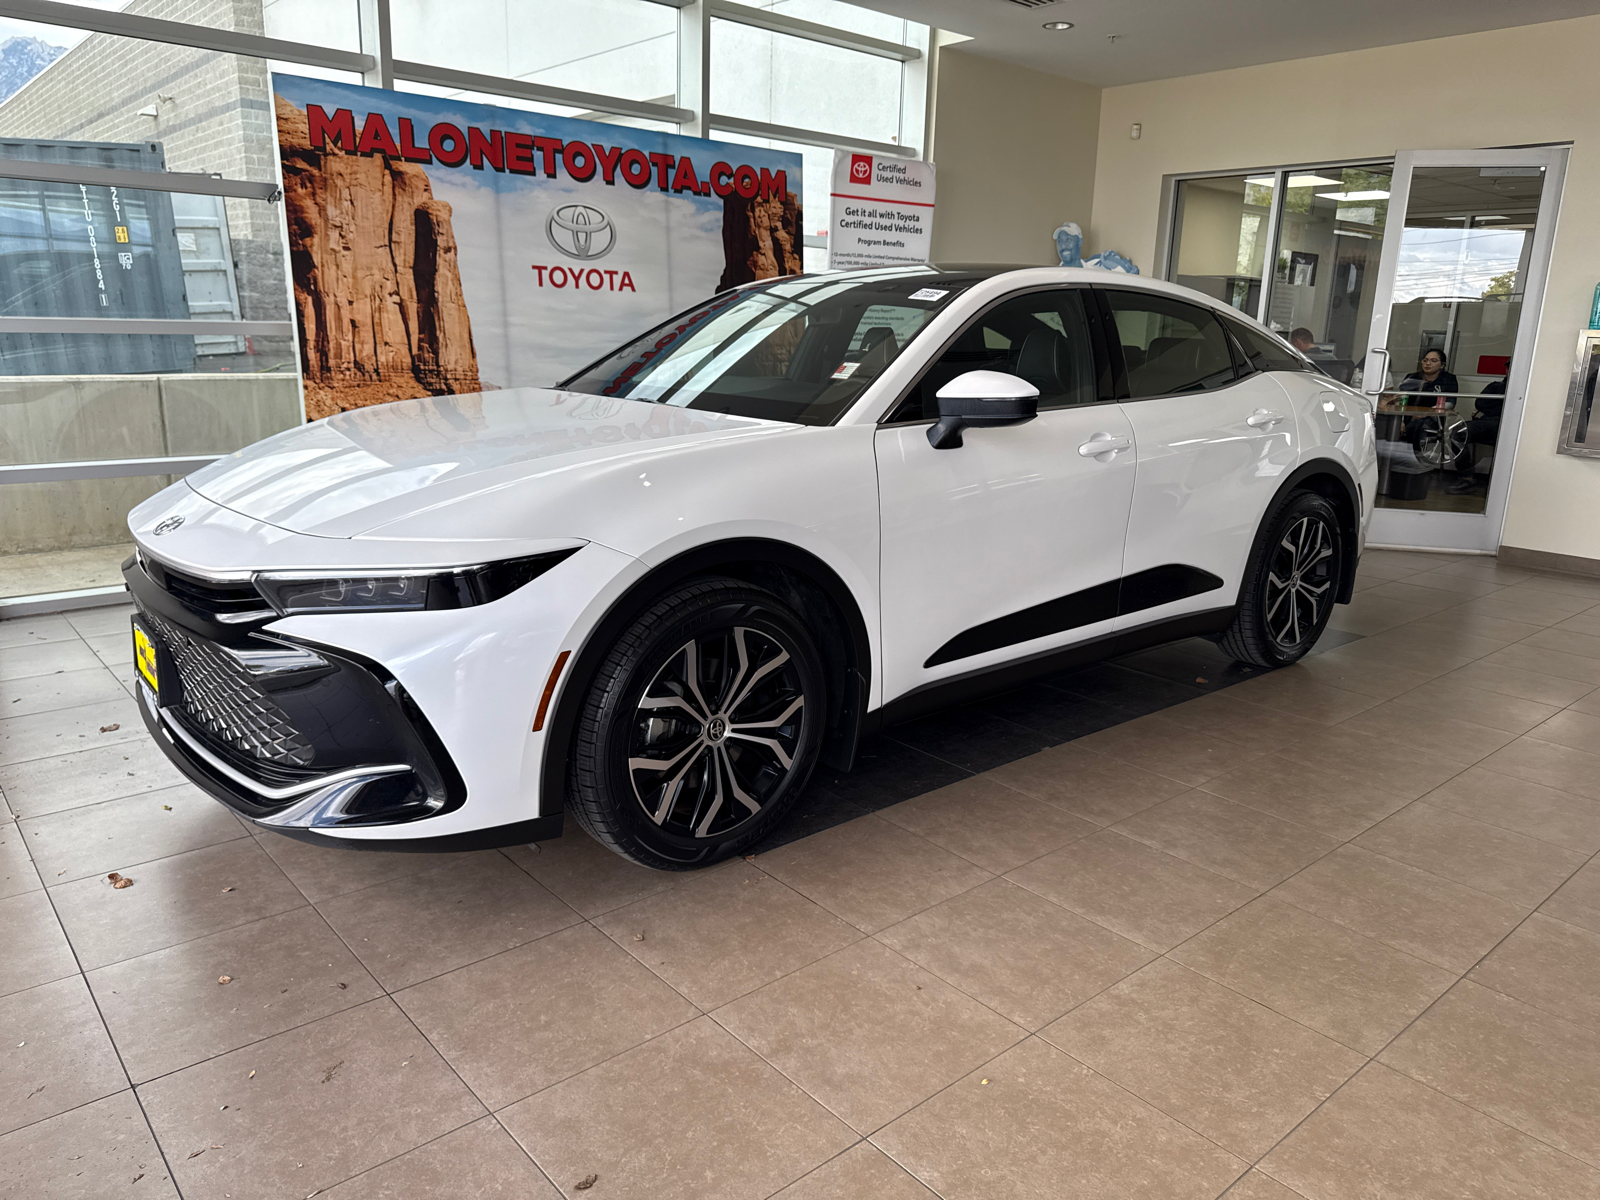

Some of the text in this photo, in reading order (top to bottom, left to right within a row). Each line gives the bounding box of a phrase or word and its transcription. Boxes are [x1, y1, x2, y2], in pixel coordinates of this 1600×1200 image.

[306, 103, 787, 201] MALONETOYOTA.COM
[877, 162, 907, 174] Certified
[876, 174, 922, 188] Used Vehicles
[110, 187, 120, 222] 2G1
[845, 207, 920, 223] Get it all with Toyota
[840, 219, 923, 235] Certified Used Vehicles
[857, 237, 905, 248] Program Benefits
[531, 264, 637, 293] TOYOTA
